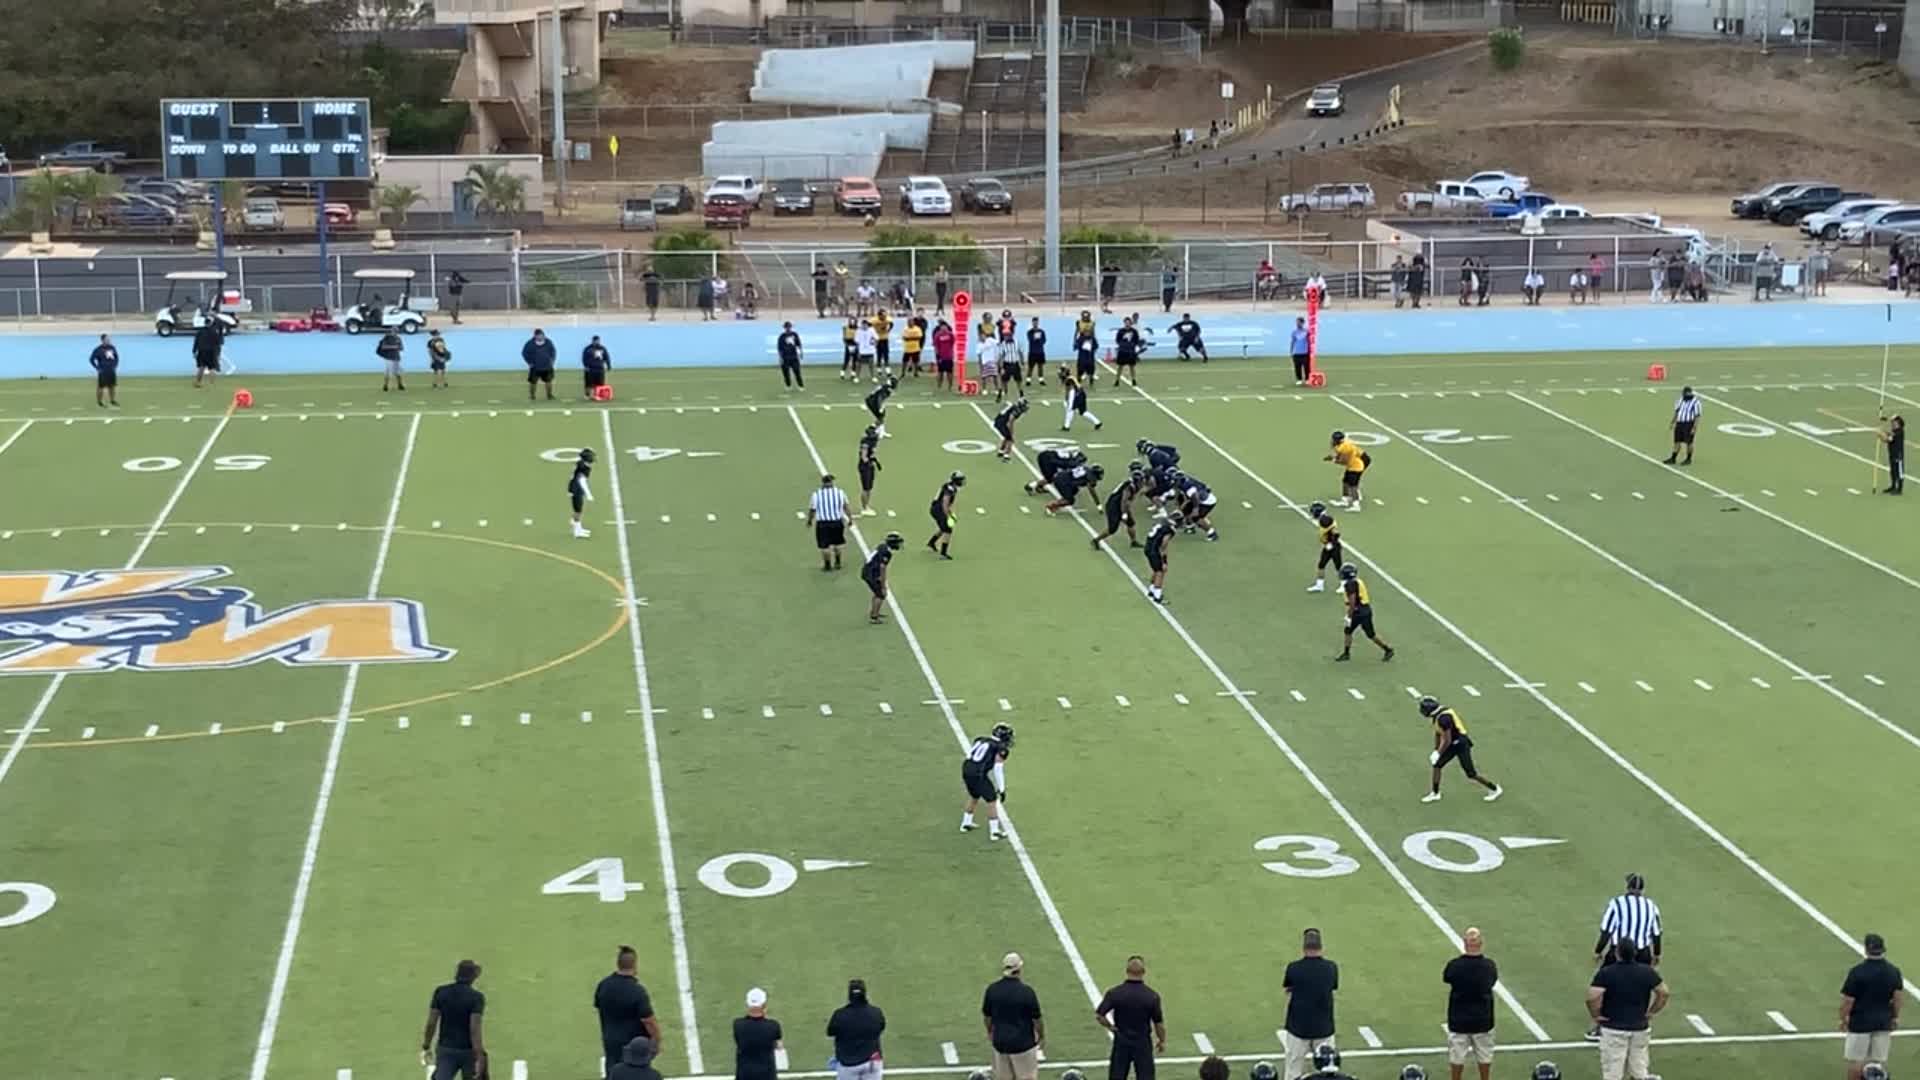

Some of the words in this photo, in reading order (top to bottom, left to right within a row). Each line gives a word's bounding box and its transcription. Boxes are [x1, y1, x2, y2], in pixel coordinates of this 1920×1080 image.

[170, 103, 219, 116] GUEST
[314, 102, 356, 115] HOME
[170, 144, 206, 155] DOWN
[222, 143, 237, 154] TO
[240, 143, 257, 154] GO
[270, 143, 300, 154] BALL
[303, 143, 320, 154] ON
[1311, 374, 1324, 386] 20
[1253, 830, 1505, 877] 30
[541, 853, 798, 902] 40
